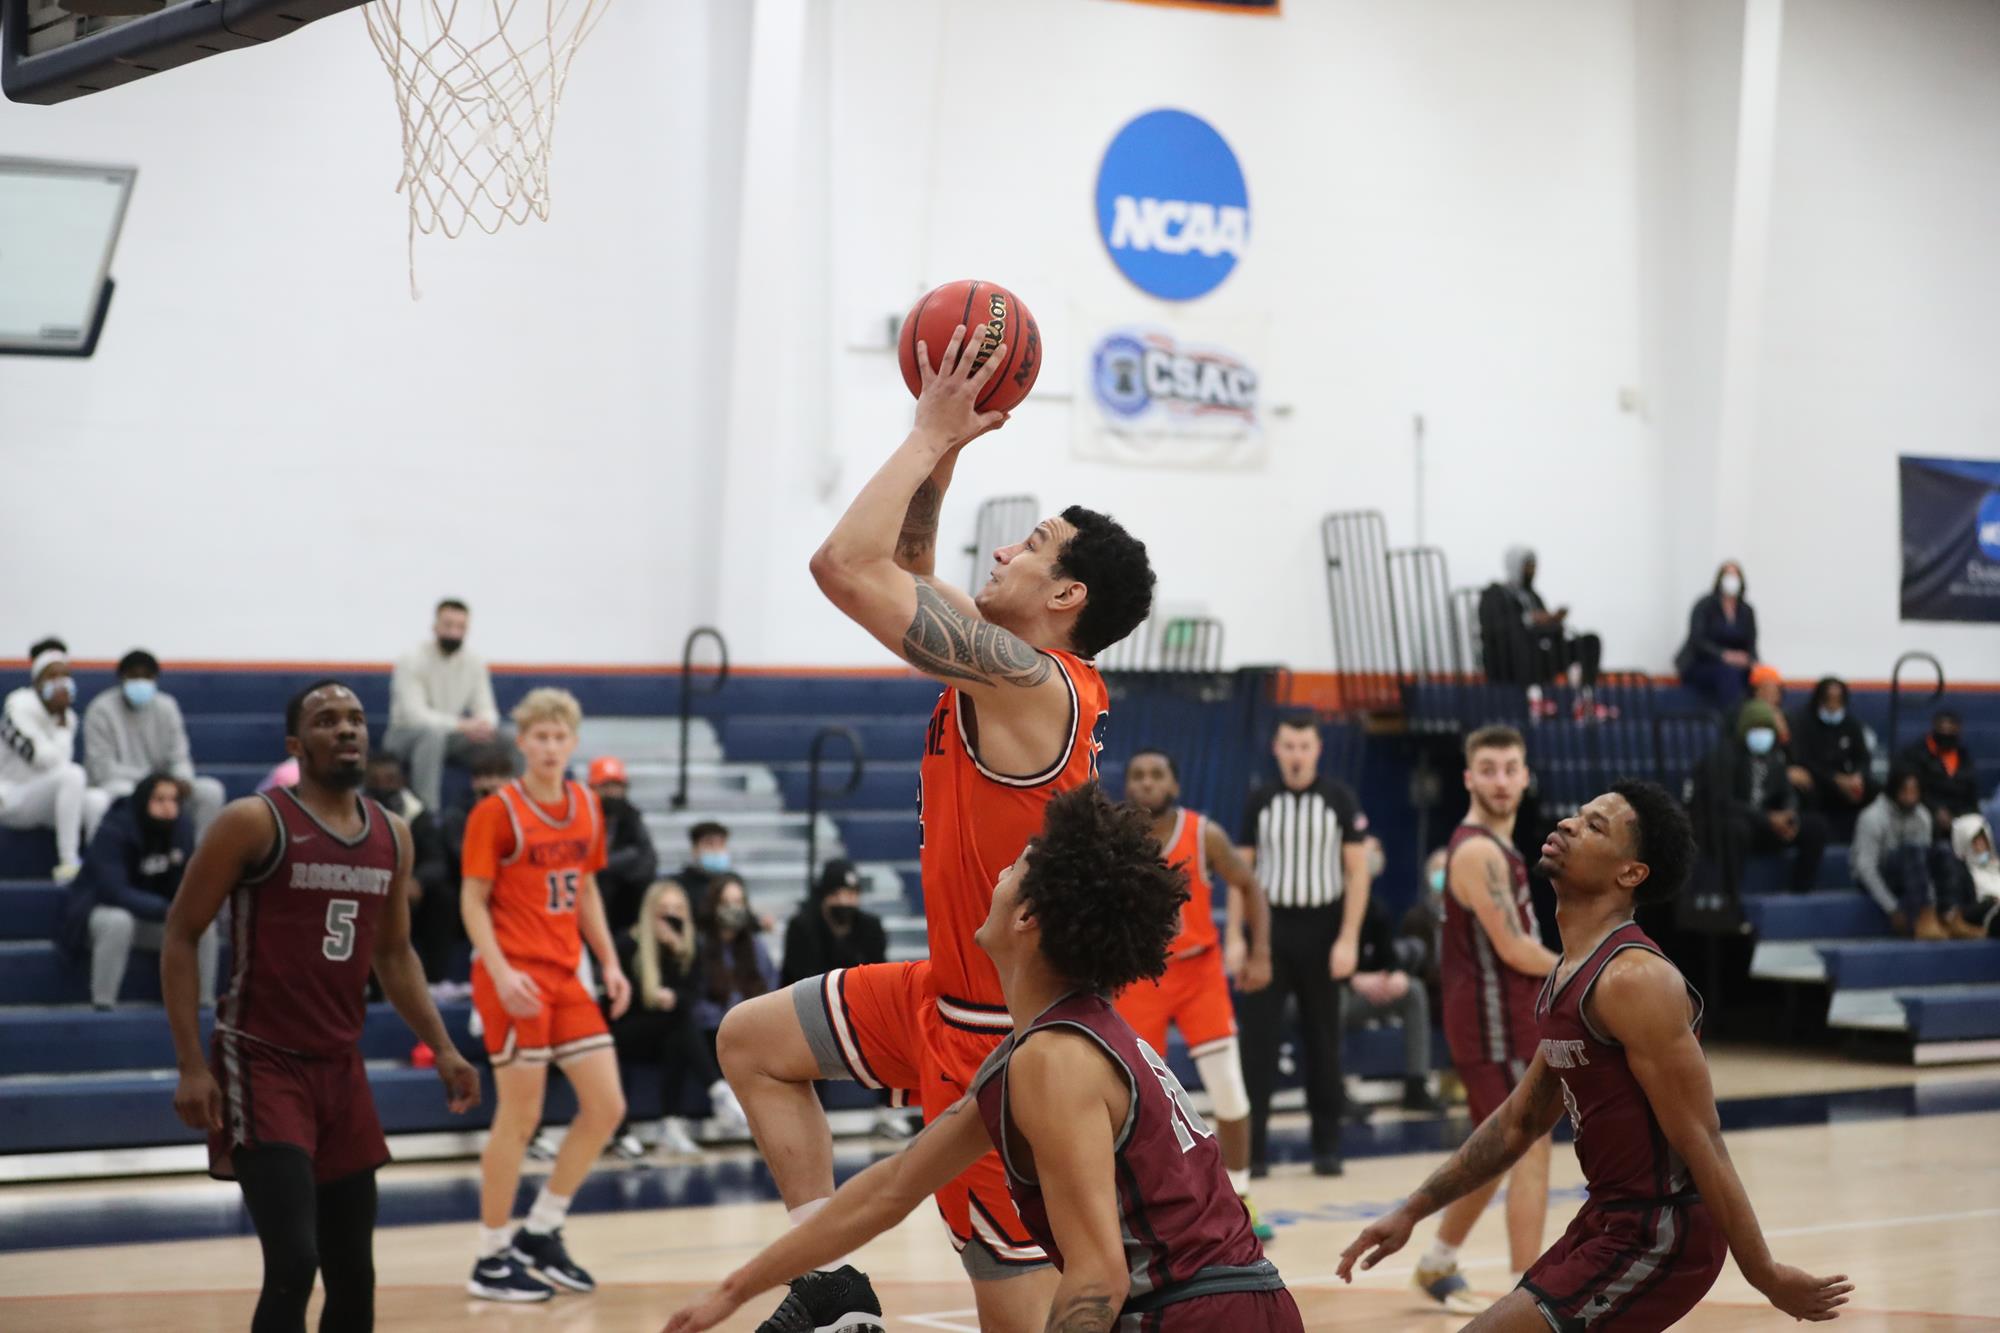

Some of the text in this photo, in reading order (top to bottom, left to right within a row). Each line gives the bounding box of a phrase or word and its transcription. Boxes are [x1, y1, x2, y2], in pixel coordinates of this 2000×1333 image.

[1110, 196, 1249, 257] NCAA
[1145, 349, 1256, 408] CSAC
[290, 863, 392, 895] ROSEMONT
[547, 869, 581, 914] 15
[322, 899, 359, 961] 5
